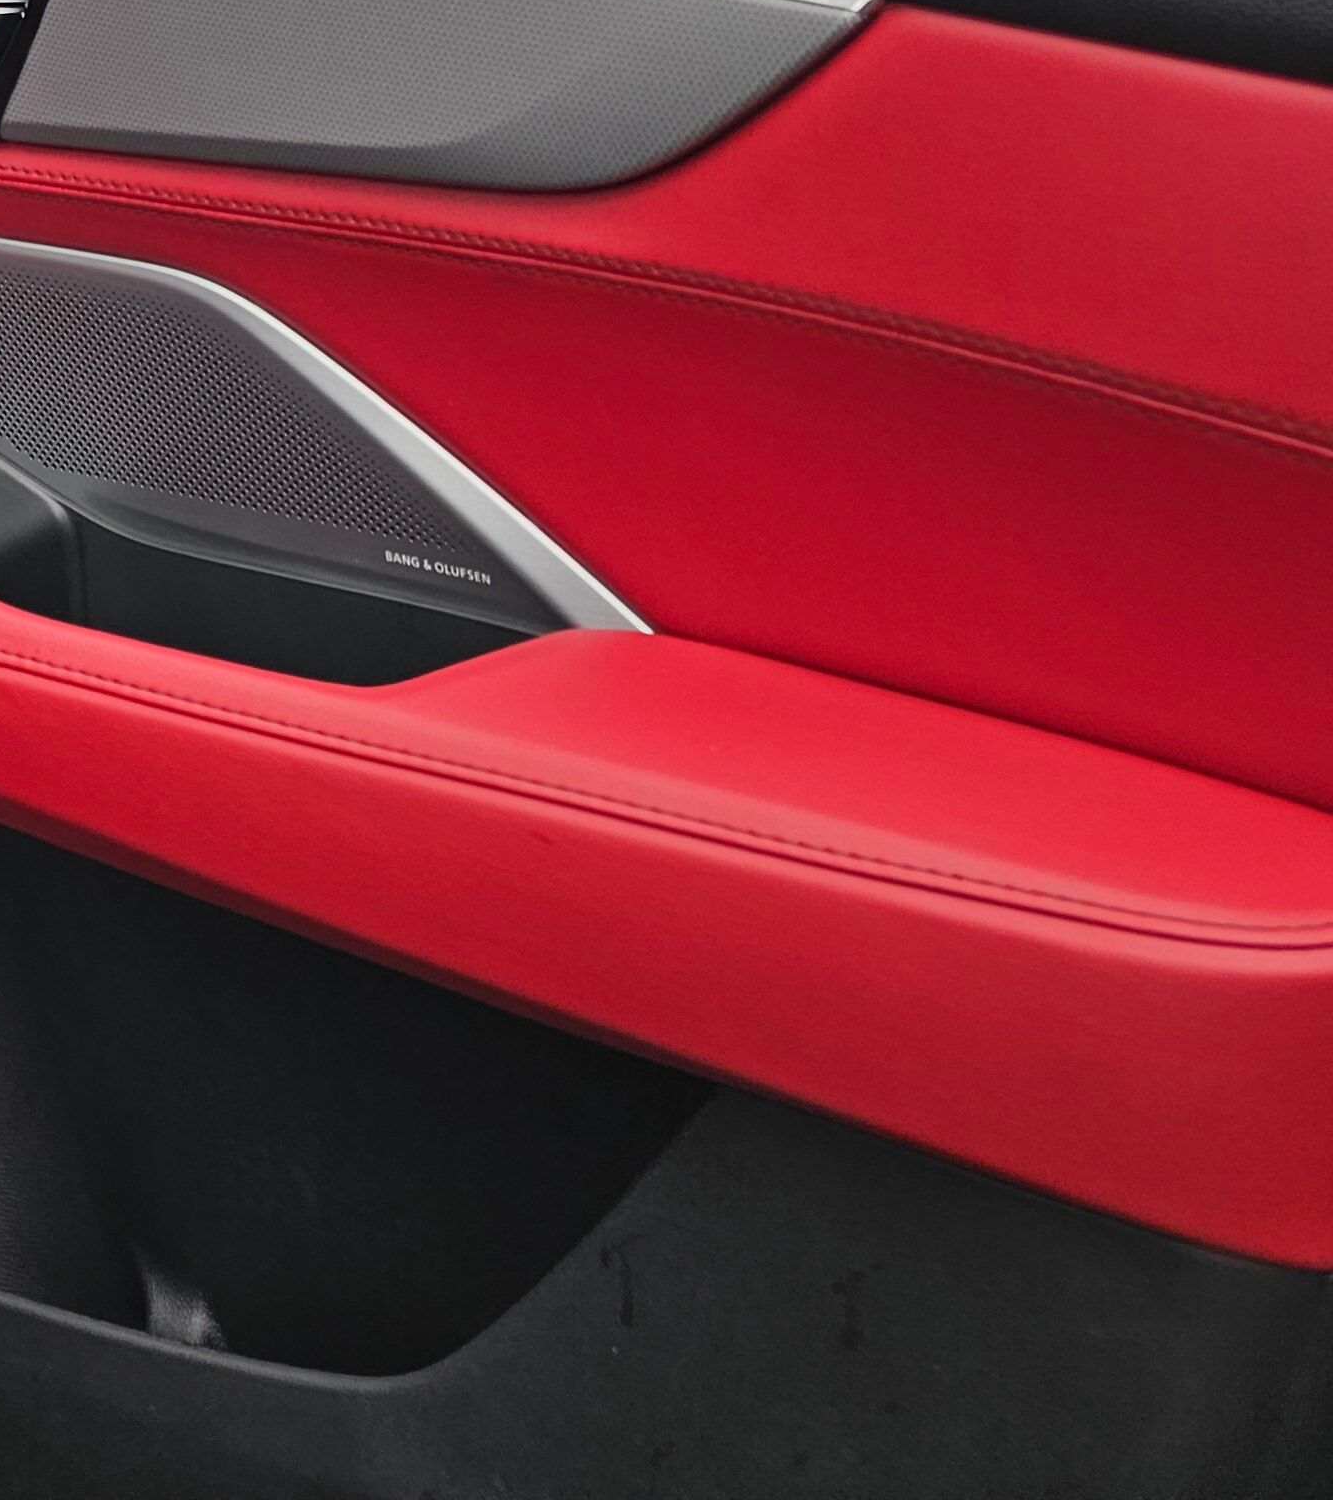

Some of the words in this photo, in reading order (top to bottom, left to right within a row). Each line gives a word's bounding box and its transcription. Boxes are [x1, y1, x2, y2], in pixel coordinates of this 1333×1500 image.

[384, 549, 420, 569] BANG
[423, 559, 432, 572] &
[434, 561, 491, 586] OLUFSEN
